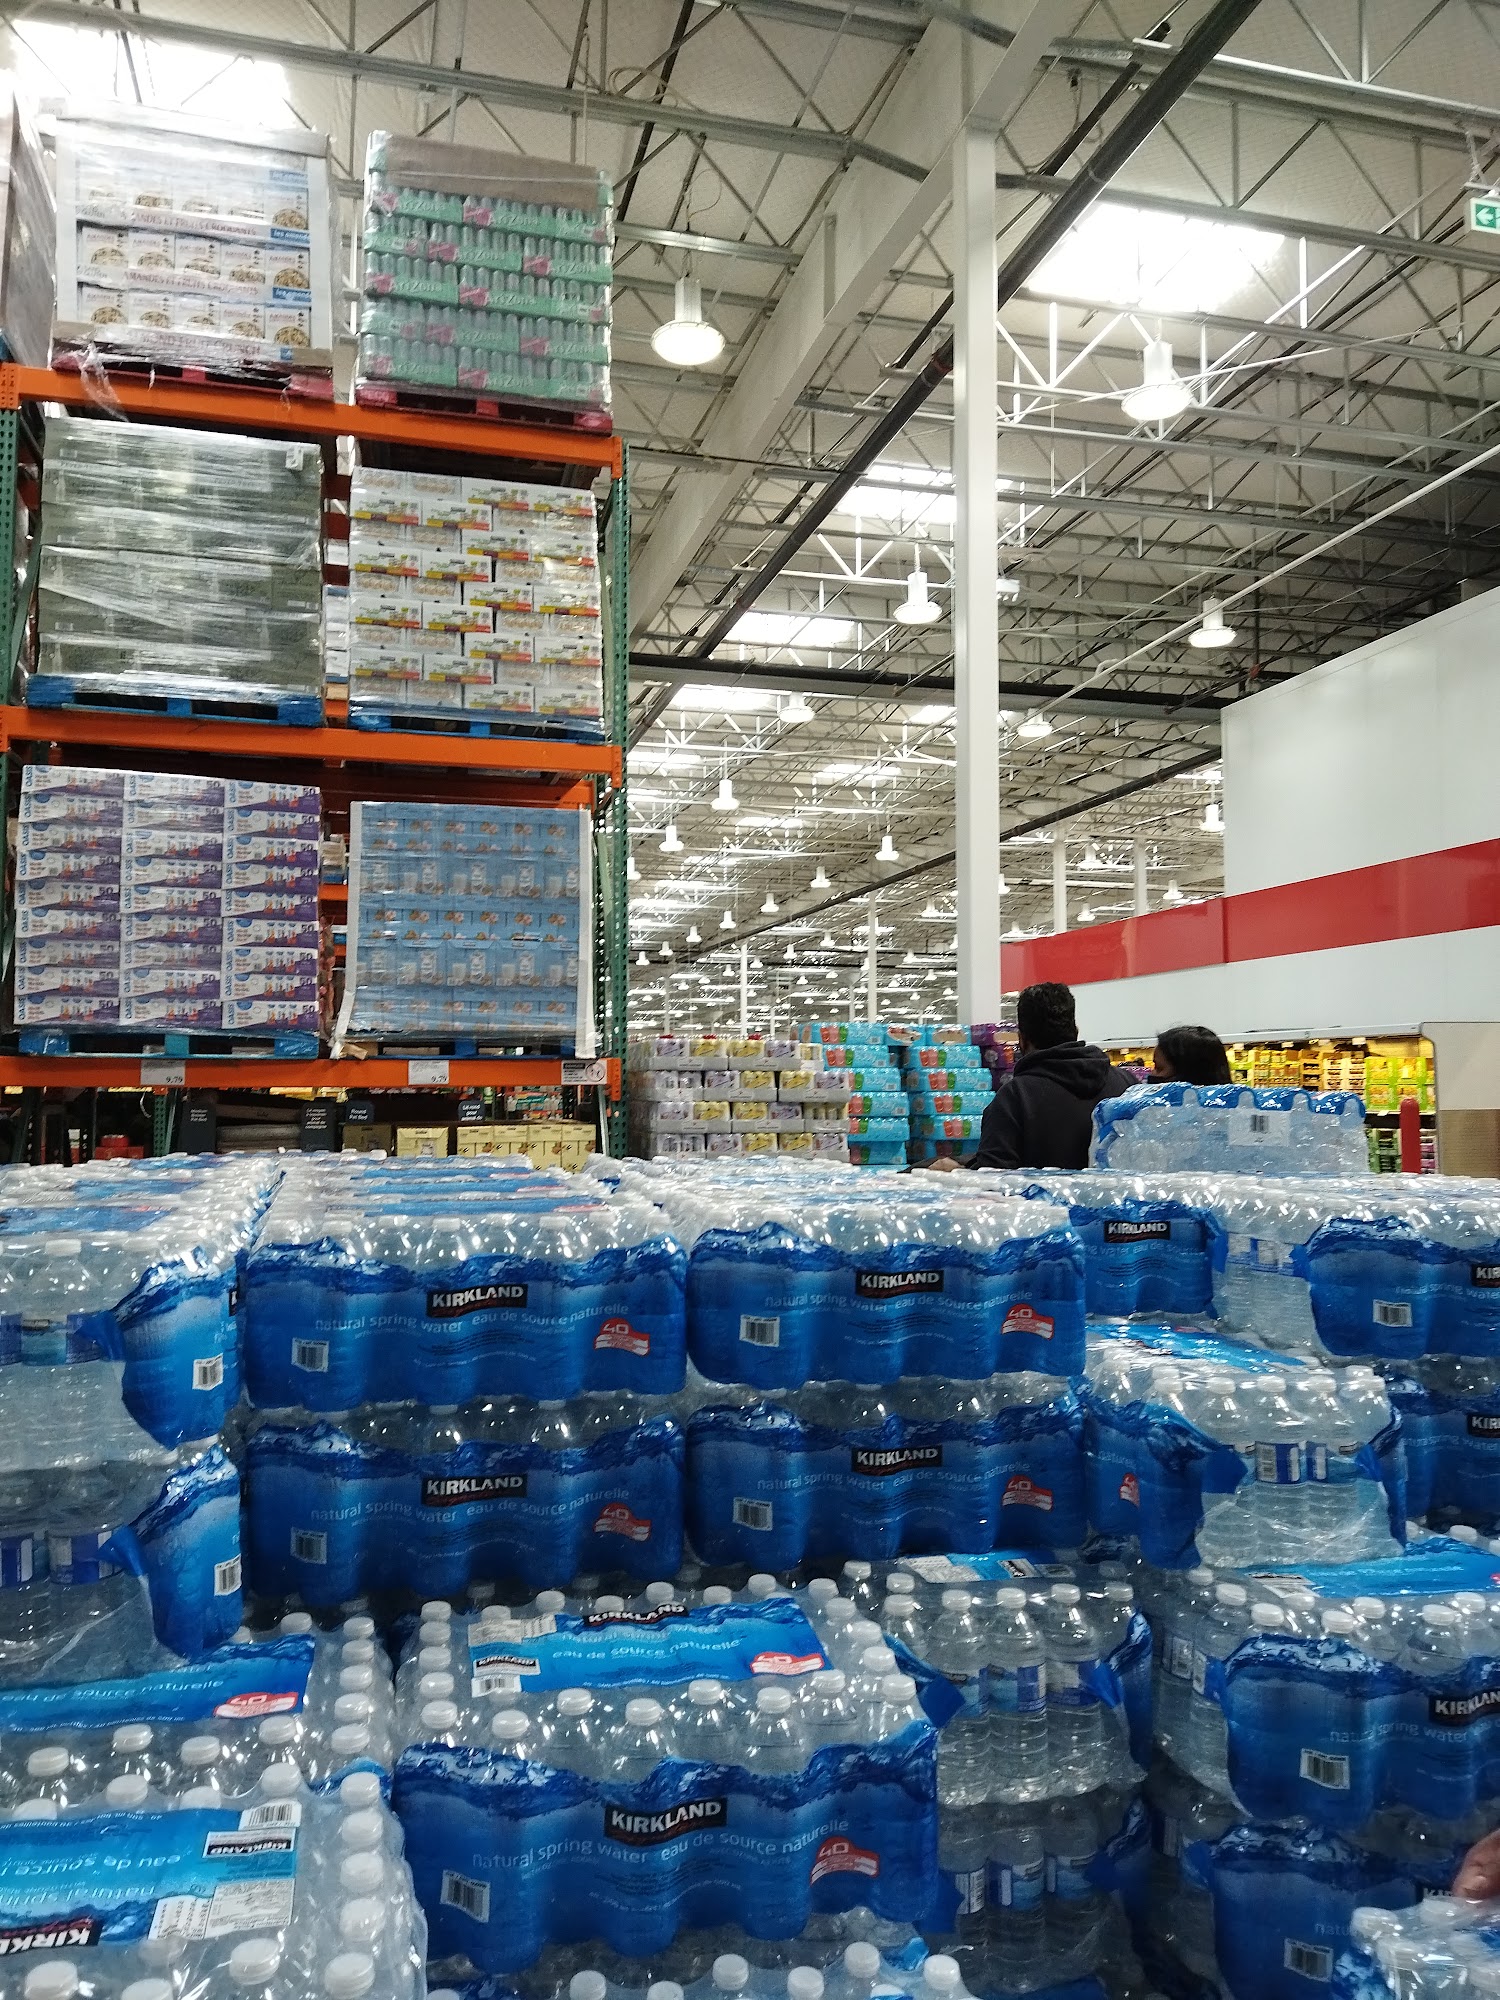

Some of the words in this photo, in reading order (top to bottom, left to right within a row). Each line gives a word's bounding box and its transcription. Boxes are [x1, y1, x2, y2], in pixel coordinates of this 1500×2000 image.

[203, 891, 216, 900] 50
[301, 924, 315, 932] 50
[303, 1005, 316, 1013] 50
[860, 1272, 940, 1290] KIRKLAND
[432, 1286, 524, 1308] KIRKLAND
[895, 1297, 915, 1309] eau
[917, 1294, 935, 1306] de
[938, 1296, 983, 1310] source
[314, 1316, 365, 1331] natural
[369, 1313, 417, 1331] spring
[421, 1320, 463, 1333] water
[472, 1312, 497, 1325] eau
[500, 1310, 517, 1322] de
[521, 1311, 567, 1326] source
[569, 1303, 629, 1323] naturelle
[1009, 1308, 1032, 1319] 40
[603, 1324, 629, 1335] 40
[857, 1448, 938, 1466] KIRKLAND
[427, 1476, 524, 1496] KIRKLAND
[756, 1474, 802, 1491] natural
[804, 1471, 843, 1488] spring
[893, 1474, 914, 1487] eau
[916, 1469, 934, 1481] de
[936, 1470, 982, 1483] source
[1008, 1480, 1032, 1491] 40
[310, 1502, 361, 1521] natural
[365, 1499, 412, 1517] spring
[415, 1508, 456, 1523] water
[466, 1504, 494, 1517] eau
[498, 1499, 517, 1511] de
[520, 1501, 566, 1516] source
[569, 1489, 629, 1511] naturelle
[603, 1508, 629, 1520] 40
[588, 1603, 685, 1624] KIRKLAND
[586, 1650, 605, 1660] de
[140, 1680, 224, 1695] naturelle
[1424, 1727, 1467, 1742] water
[612, 1801, 722, 1834] KIRKLAND
[210, 1842, 288, 1856] KIRKLAND
[472, 1847, 534, 1868] natural
[538, 1838, 593, 1861] spring
[597, 1842, 649, 1864] water
[661, 1840, 688, 1861] eau
[693, 1833, 713, 1847] de
[719, 1833, 776, 1856] source
[782, 1819, 850, 1854] naturelle
[818, 1843, 850, 1858] 40
[104, 1856, 132, 1871] de
[139, 1855, 181, 1869] eau
[1315, 1923, 1351, 1936] natu
